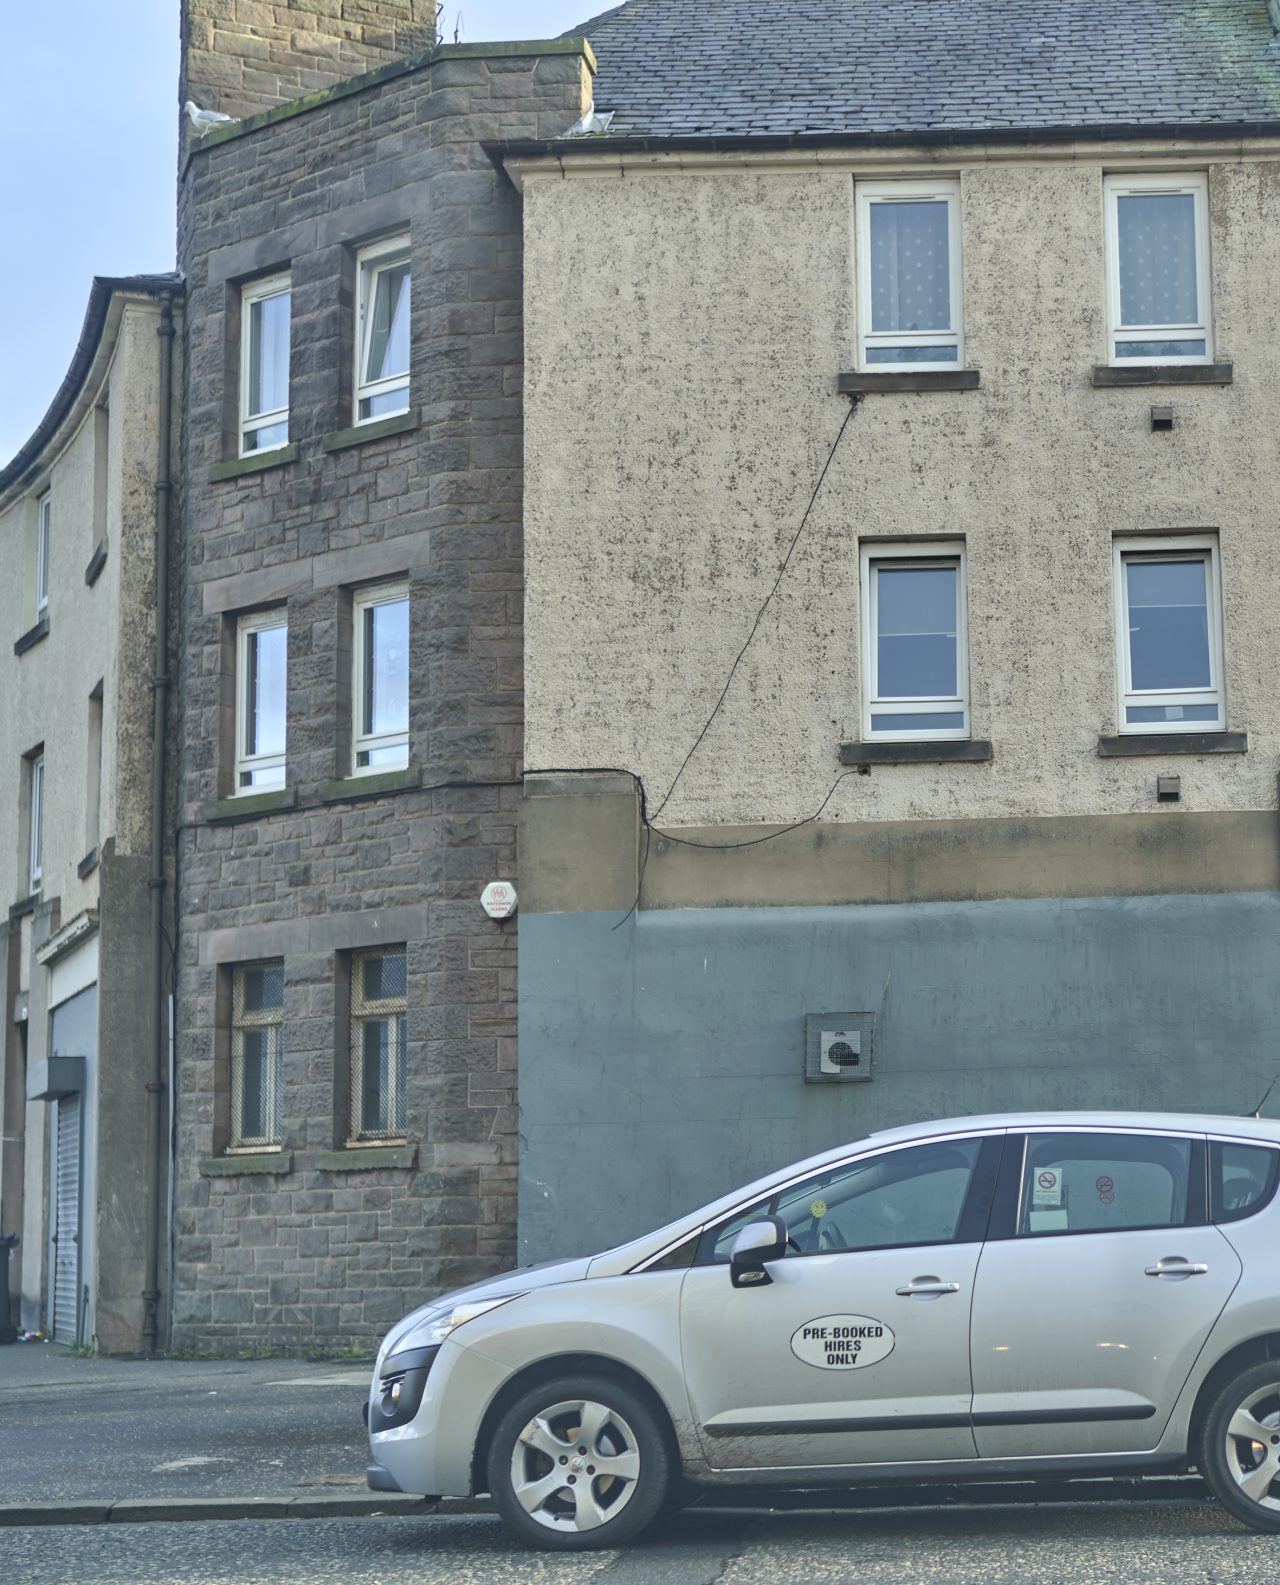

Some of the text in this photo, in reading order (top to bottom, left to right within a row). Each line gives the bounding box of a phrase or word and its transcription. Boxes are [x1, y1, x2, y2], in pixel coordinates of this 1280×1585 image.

[803, 1326, 883, 1339] PRE-BOOKED
[824, 1340, 862, 1352] HIRES
[827, 1353, 858, 1365] ONLY
